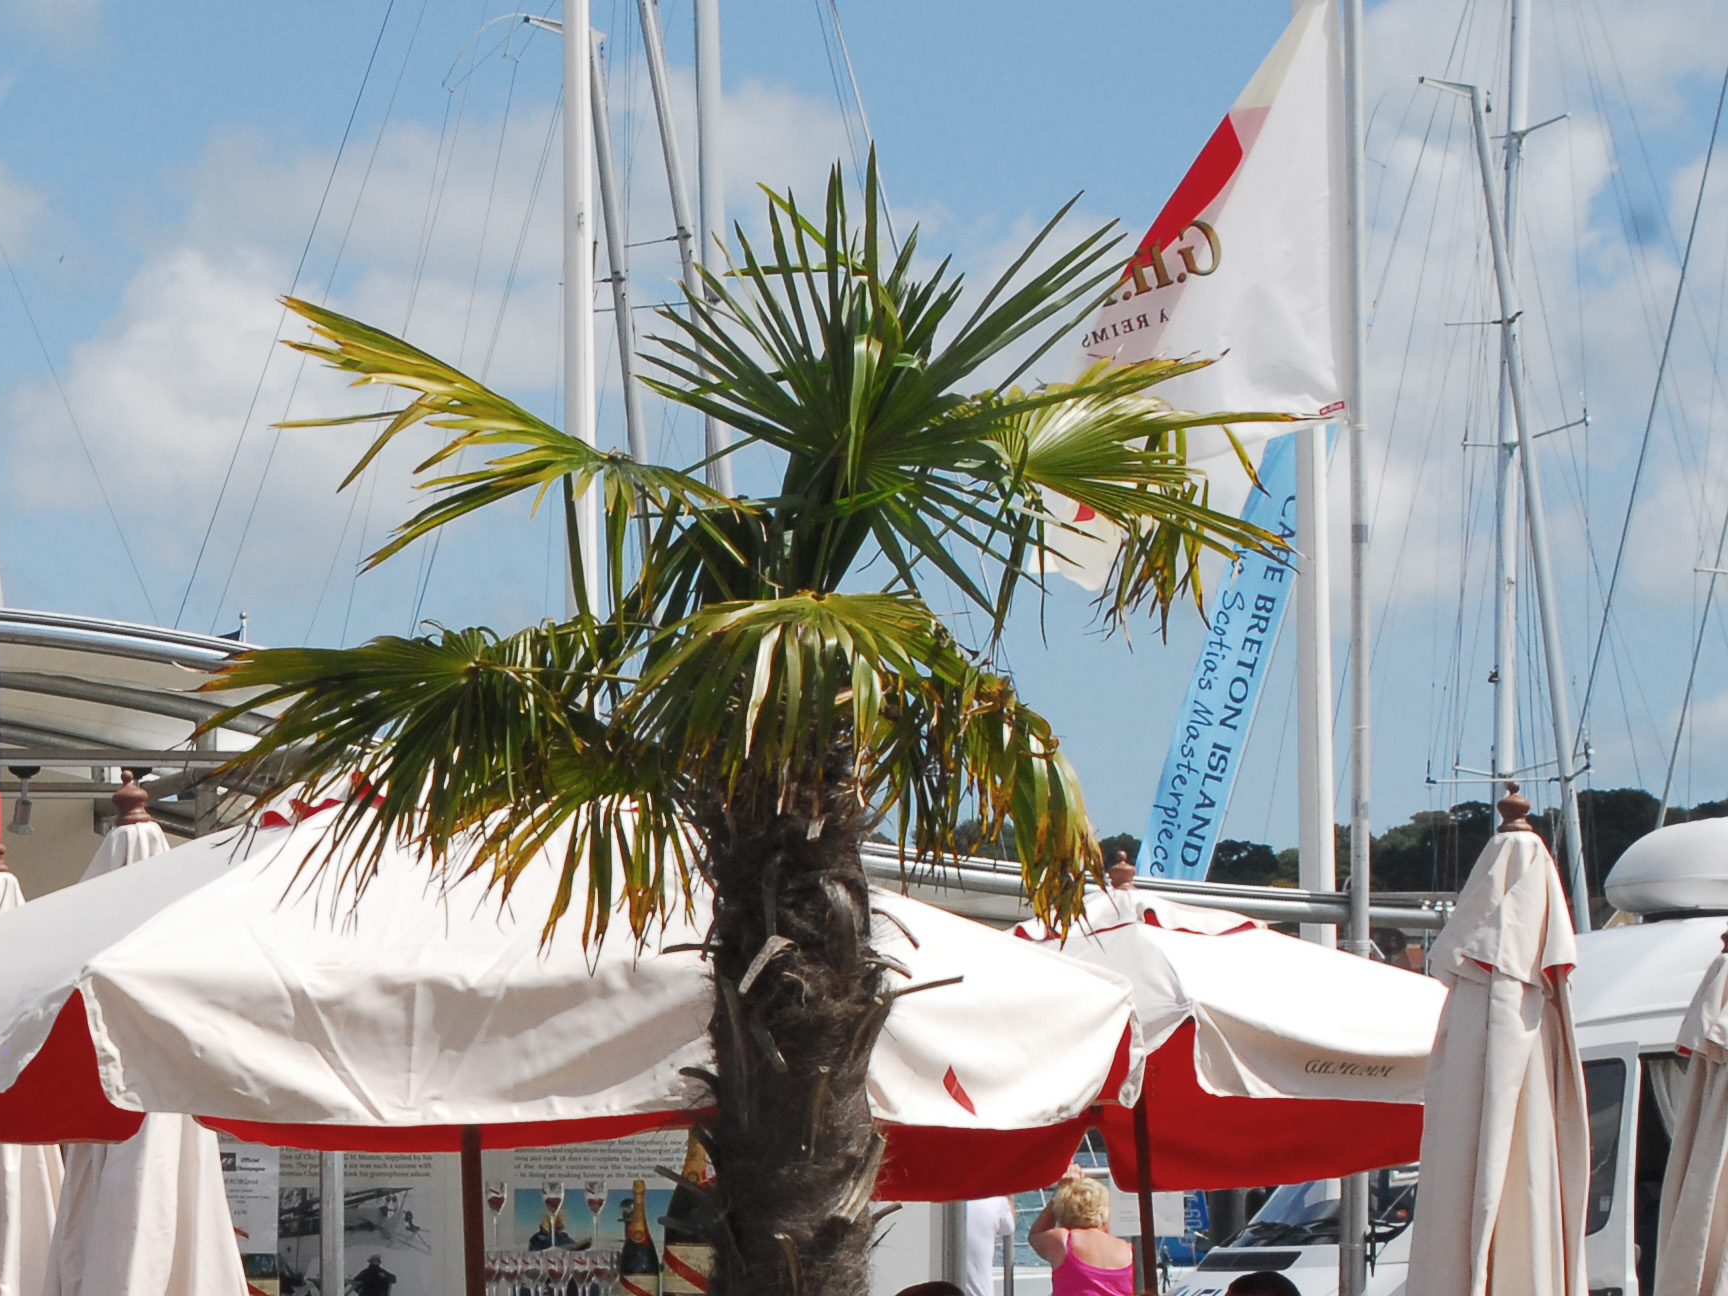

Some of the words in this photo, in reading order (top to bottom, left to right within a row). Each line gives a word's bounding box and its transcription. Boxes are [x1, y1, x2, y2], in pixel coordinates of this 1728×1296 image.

[1219, 592, 1276, 731] BRETON
[1150, 699, 1214, 877] Masterpiece
[1180, 741, 1232, 868] ISLAND
